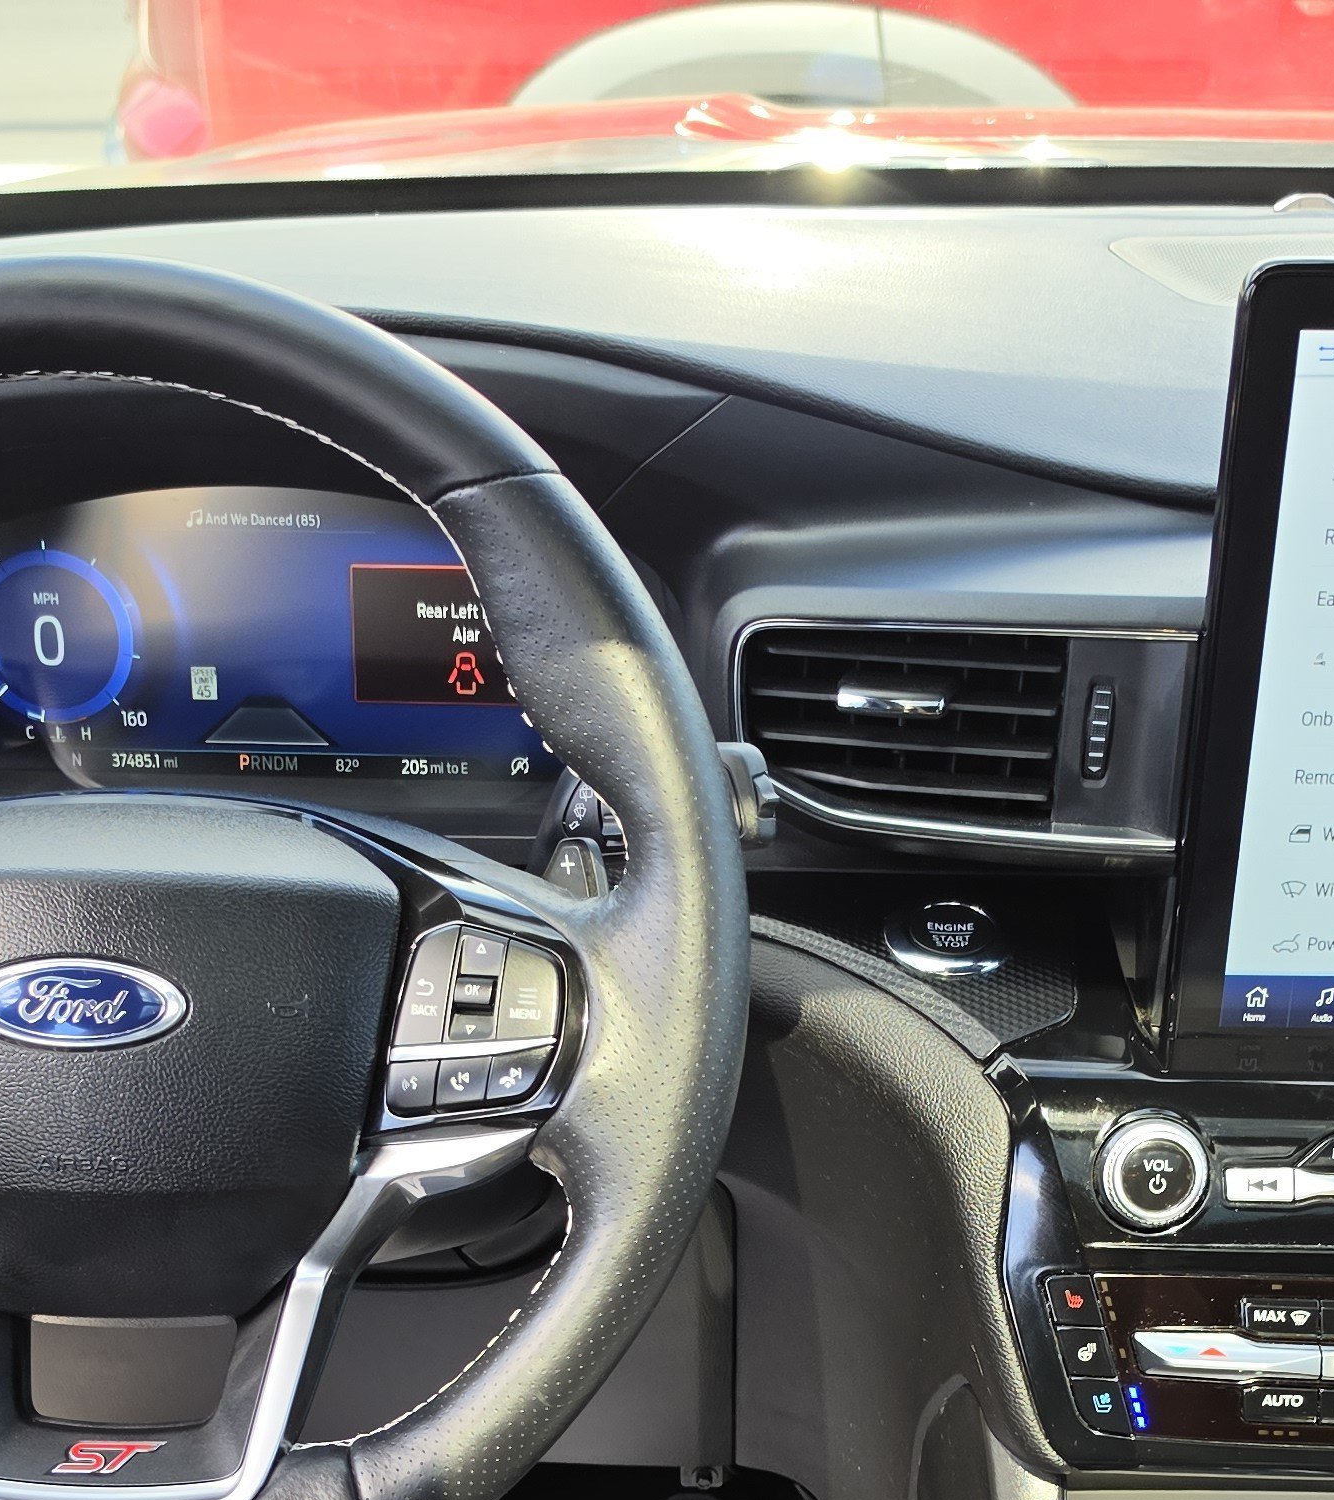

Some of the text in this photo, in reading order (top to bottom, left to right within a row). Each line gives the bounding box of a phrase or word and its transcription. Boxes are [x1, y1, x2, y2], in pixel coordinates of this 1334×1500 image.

[204, 513, 321, 529] And We Danced (85)
[32, 592, 60, 605] MPH
[416, 602, 449, 619] Rear
[451, 602, 479, 619] Left
[33, 614, 65, 667] 0
[452, 625, 481, 644] Ajar
[196, 686, 212, 698] 45
[121, 710, 148, 727] 160
[25, 725, 36, 740] C
[81, 727, 92, 741] H
[111, 753, 178, 769] 37485.1 mi
[239, 754, 298, 771] PRNDM
[401, 759, 469, 775] 205 mi to E
[926, 921, 975, 932] ENGINE
[932, 934, 971, 942] START
[464, 984, 481, 996] OK
[16, 974, 130, 1026] Ford
[410, 1004, 438, 1017] BACK
[509, 1007, 542, 1021] MENU
[1242, 1012, 1266, 1023] Home
[1310, 1013, 1333, 1024] Audio
[1142, 1158, 1174, 1172] VOL
[1253, 1310, 1286, 1323] MAX
[1261, 1395, 1304, 1408] AUTO
[52, 1440, 167, 1474] ST
